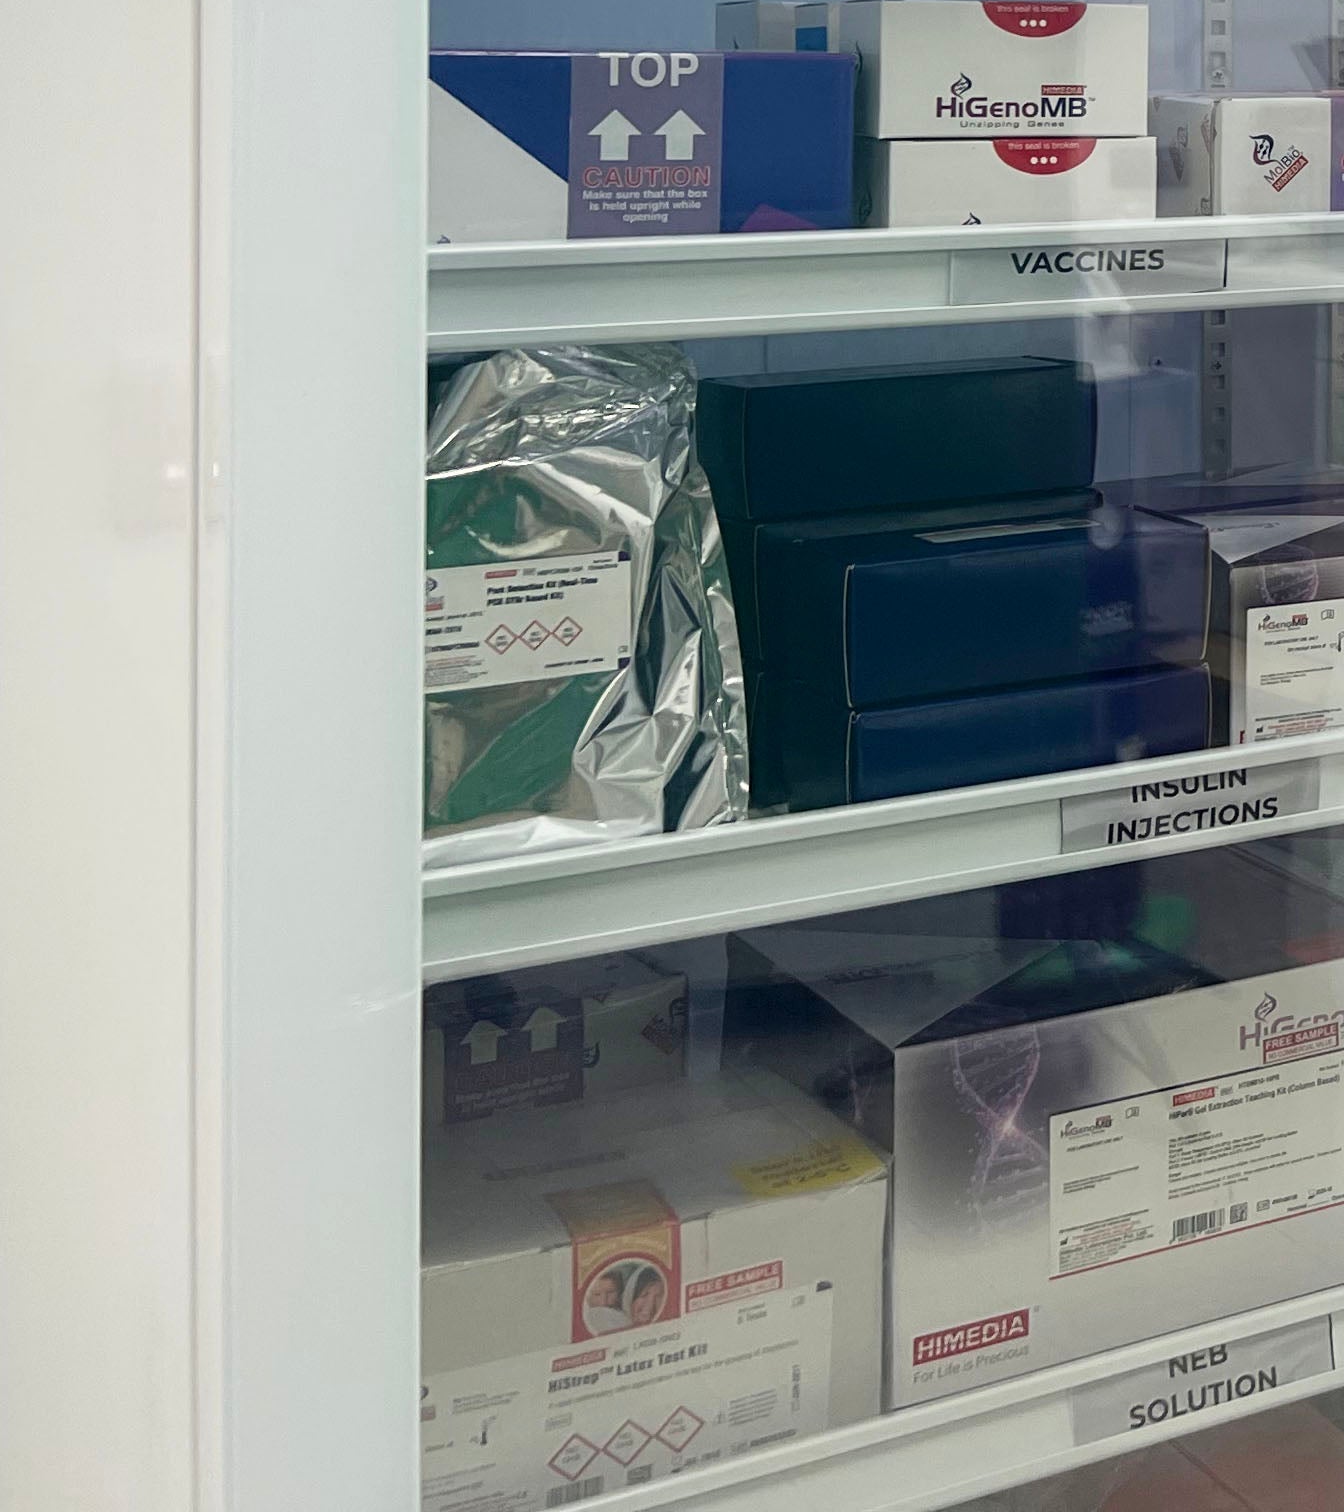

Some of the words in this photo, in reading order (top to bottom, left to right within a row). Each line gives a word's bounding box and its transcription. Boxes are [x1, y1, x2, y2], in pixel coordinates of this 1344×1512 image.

[598, 52, 699, 88] TOP
[582, 165, 711, 188] CAUTION
[582, 190, 612, 200] Make
[667, 189, 685, 198] the
[687, 189, 708, 198] box
[1010, 249, 1165, 274] VACCINES
[1131, 768, 1247, 803] INSULIN
[1108, 796, 1279, 845] INJECTIONS
[1265, 1034, 1294, 1051] FREE
[1295, 1024, 1337, 1044] SAMPLE
[1208, 1098, 1243, 1111] Extraction
[1244, 1091, 1276, 1104] Teaching
[1277, 1086, 1287, 1096] Kit
[1287, 1080, 1315, 1095] (Column
[1317, 1074, 1340, 1086] Based)
[727, 1262, 781, 1291] SAMPLE
[917, 1314, 1024, 1361] HIMEDIA
[913, 1370, 934, 1384] For
[938, 1361, 959, 1378] Life
[961, 1360, 974, 1372] is
[975, 1344, 1029, 1367] Precious
[1168, 1343, 1228, 1378] NEB
[1130, 1366, 1277, 1430] SOLUTION
